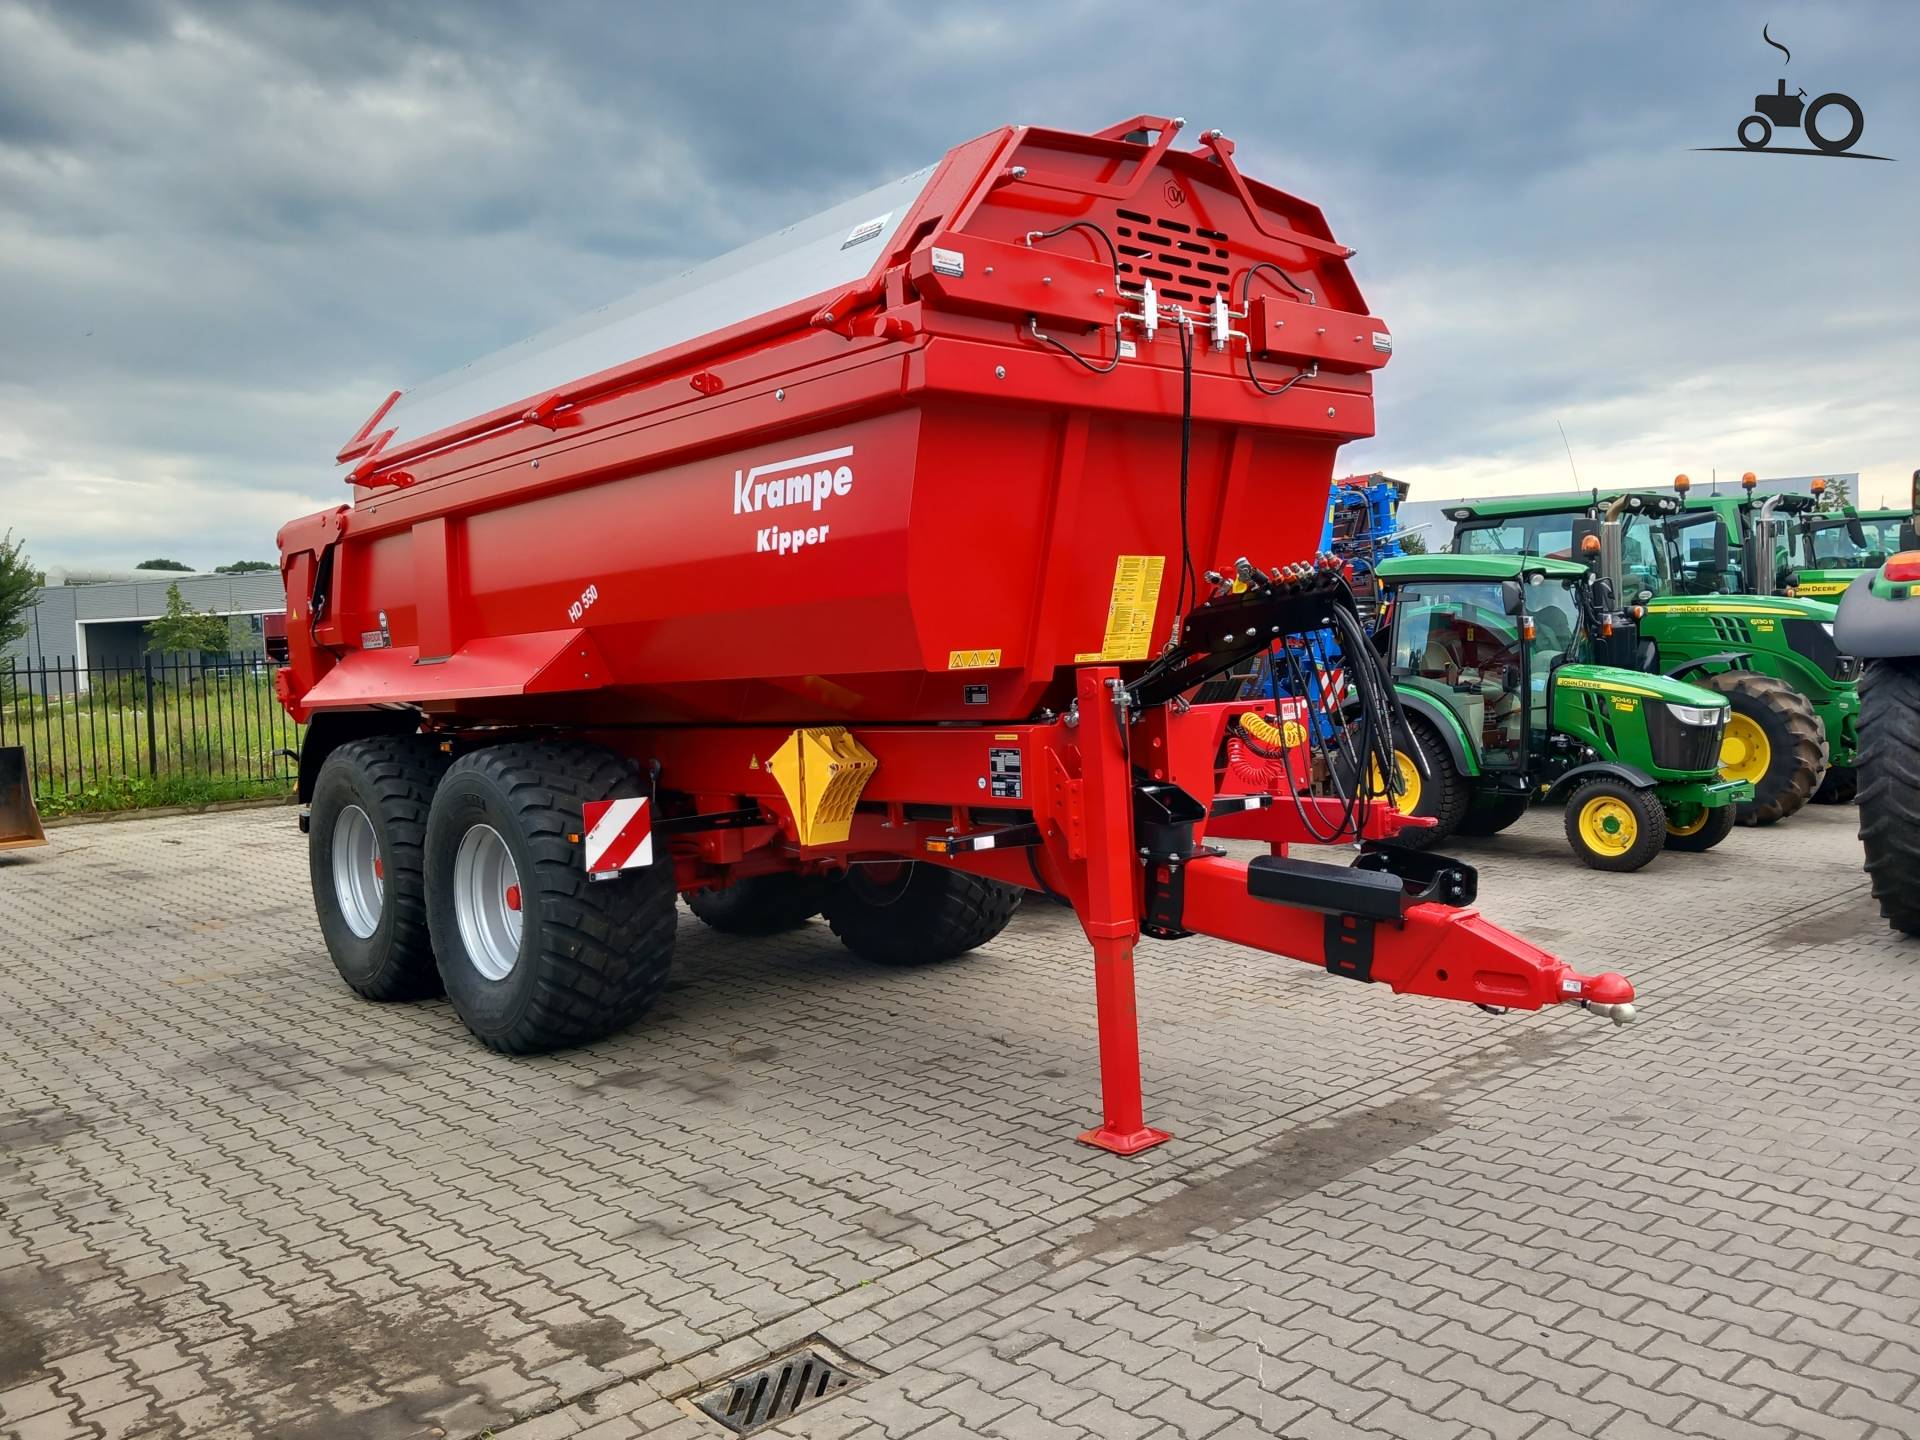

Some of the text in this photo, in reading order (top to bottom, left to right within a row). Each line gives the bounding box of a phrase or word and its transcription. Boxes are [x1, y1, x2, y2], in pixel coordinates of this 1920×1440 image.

[733, 445, 854, 515] Krampe
[756, 525, 829, 555] Kipper
[568, 584, 598, 624] HD 550
[1578, 681, 1602, 689] DEERE
[1611, 695, 1632, 704] 3046
